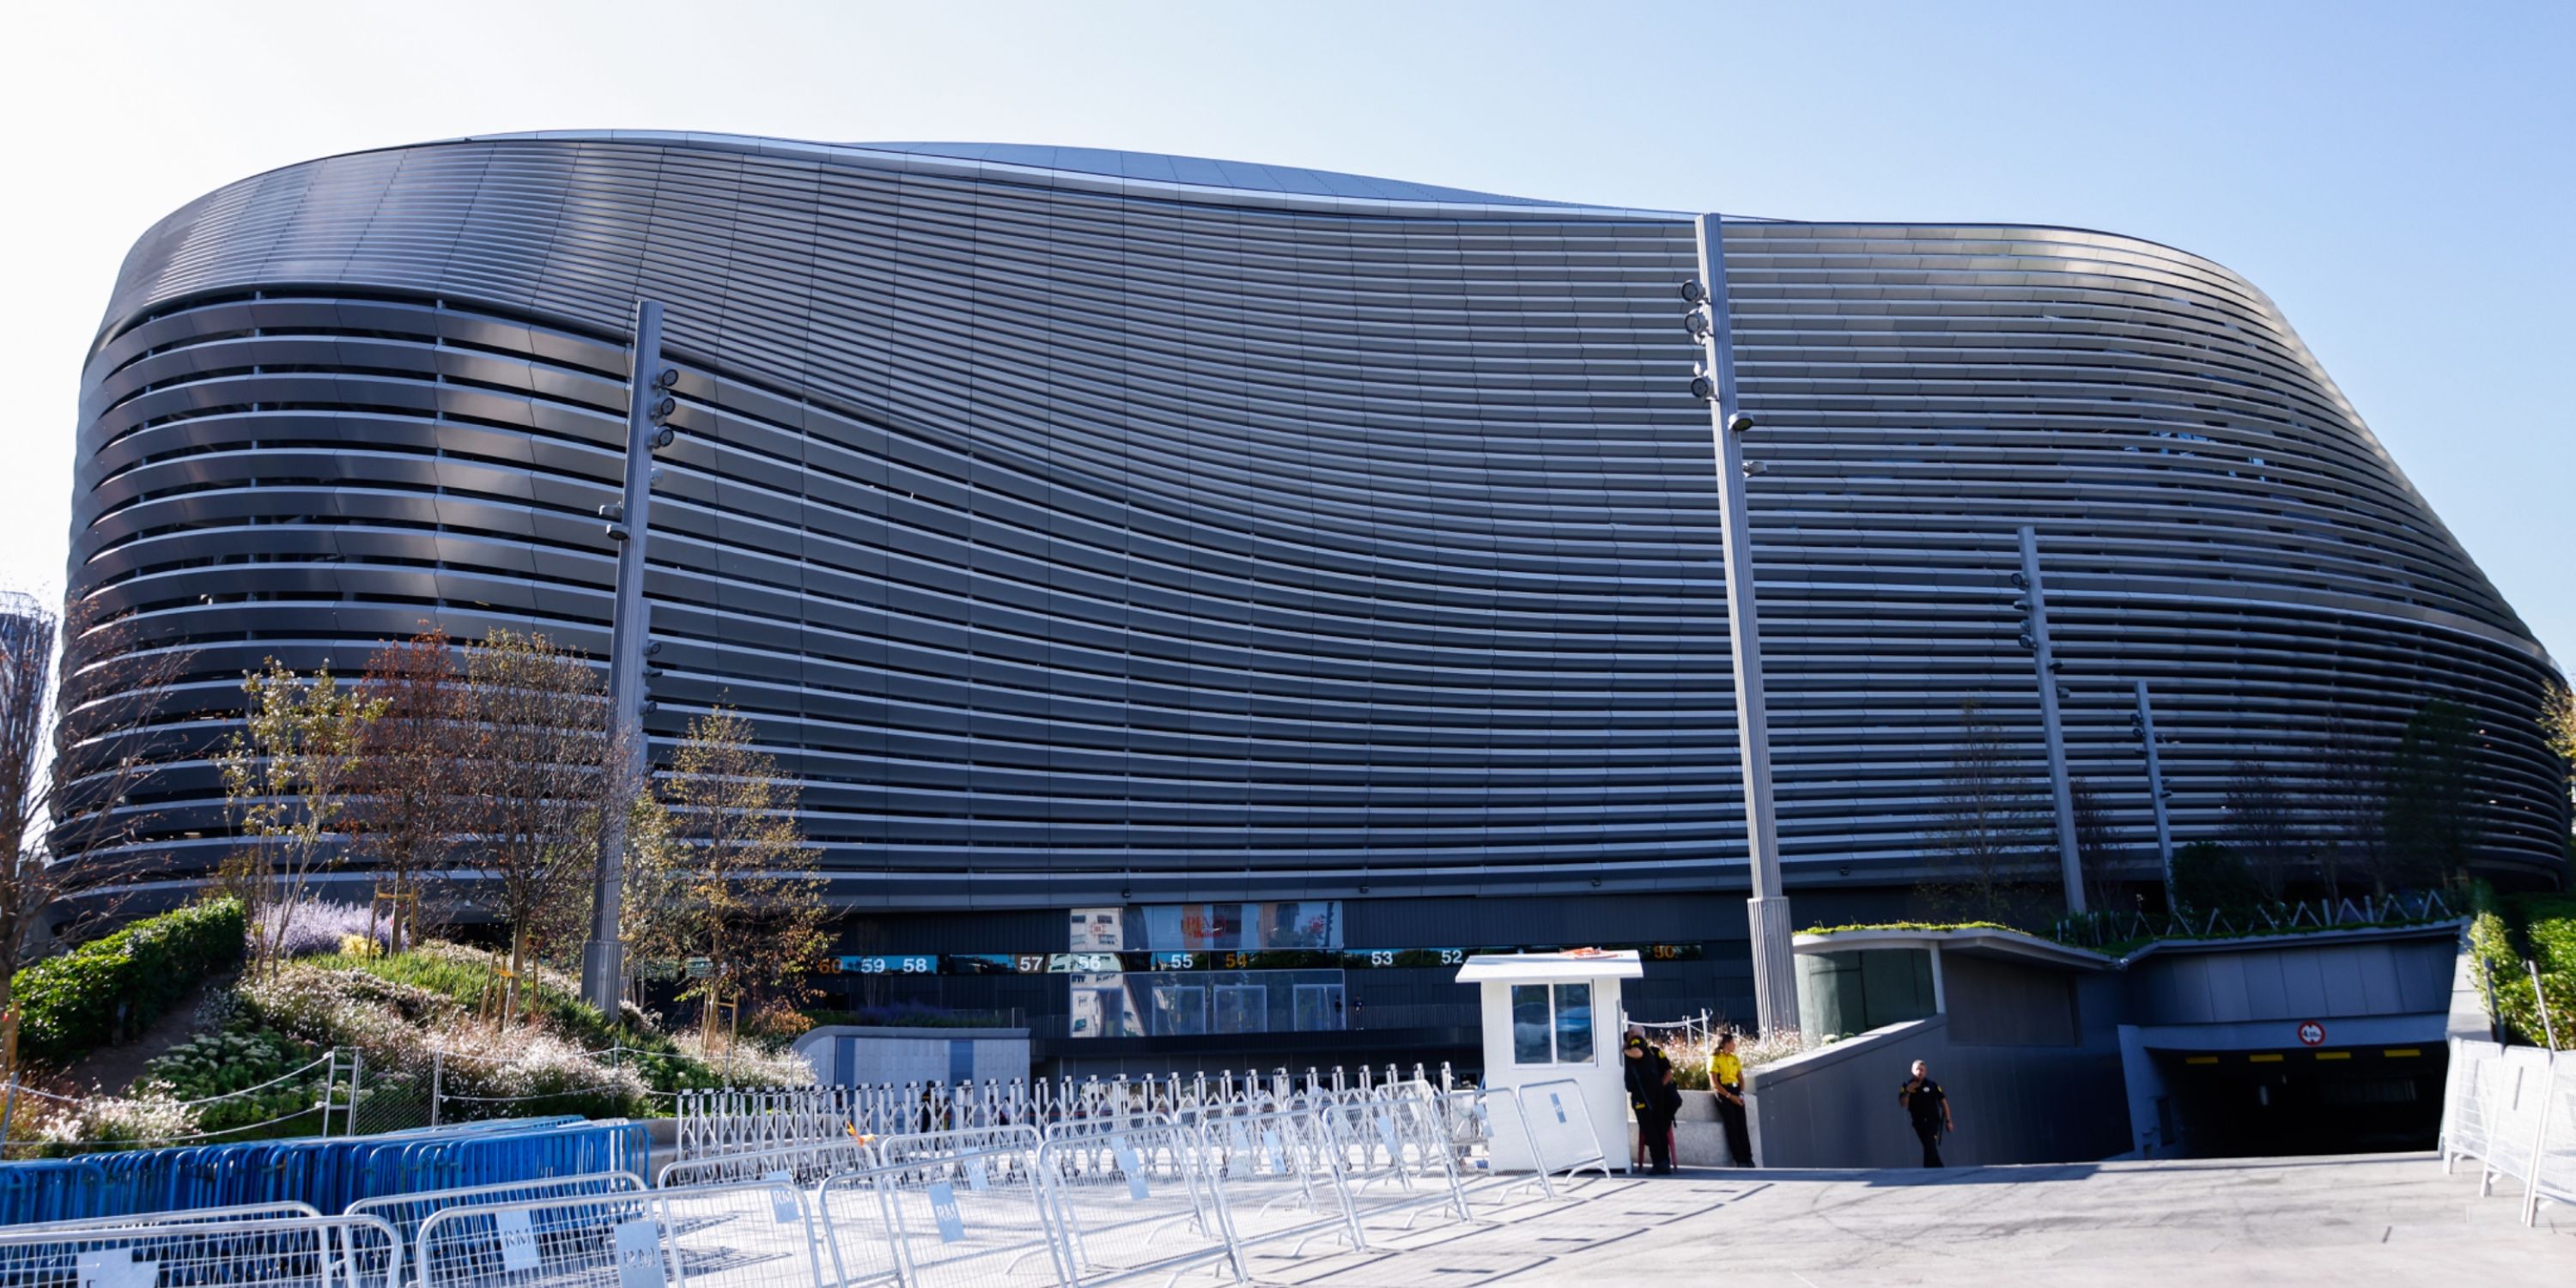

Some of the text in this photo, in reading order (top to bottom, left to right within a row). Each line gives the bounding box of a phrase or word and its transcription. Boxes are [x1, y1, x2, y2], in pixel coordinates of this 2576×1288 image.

[1019, 957, 1043, 971] 57
[1078, 956, 1101, 969] 56
[1171, 954, 1193, 968] 55
[1225, 953, 1247, 968] 54
[1371, 951, 1393, 965] 53
[1441, 950, 1462, 963] 52
[817, 958, 842, 974] 60
[861, 958, 885, 973] 59
[903, 957, 927, 972] 58
[773, 1190, 794, 1205] RM
[936, 1202, 957, 1221] RM
[504, 1229, 531, 1248] RM
